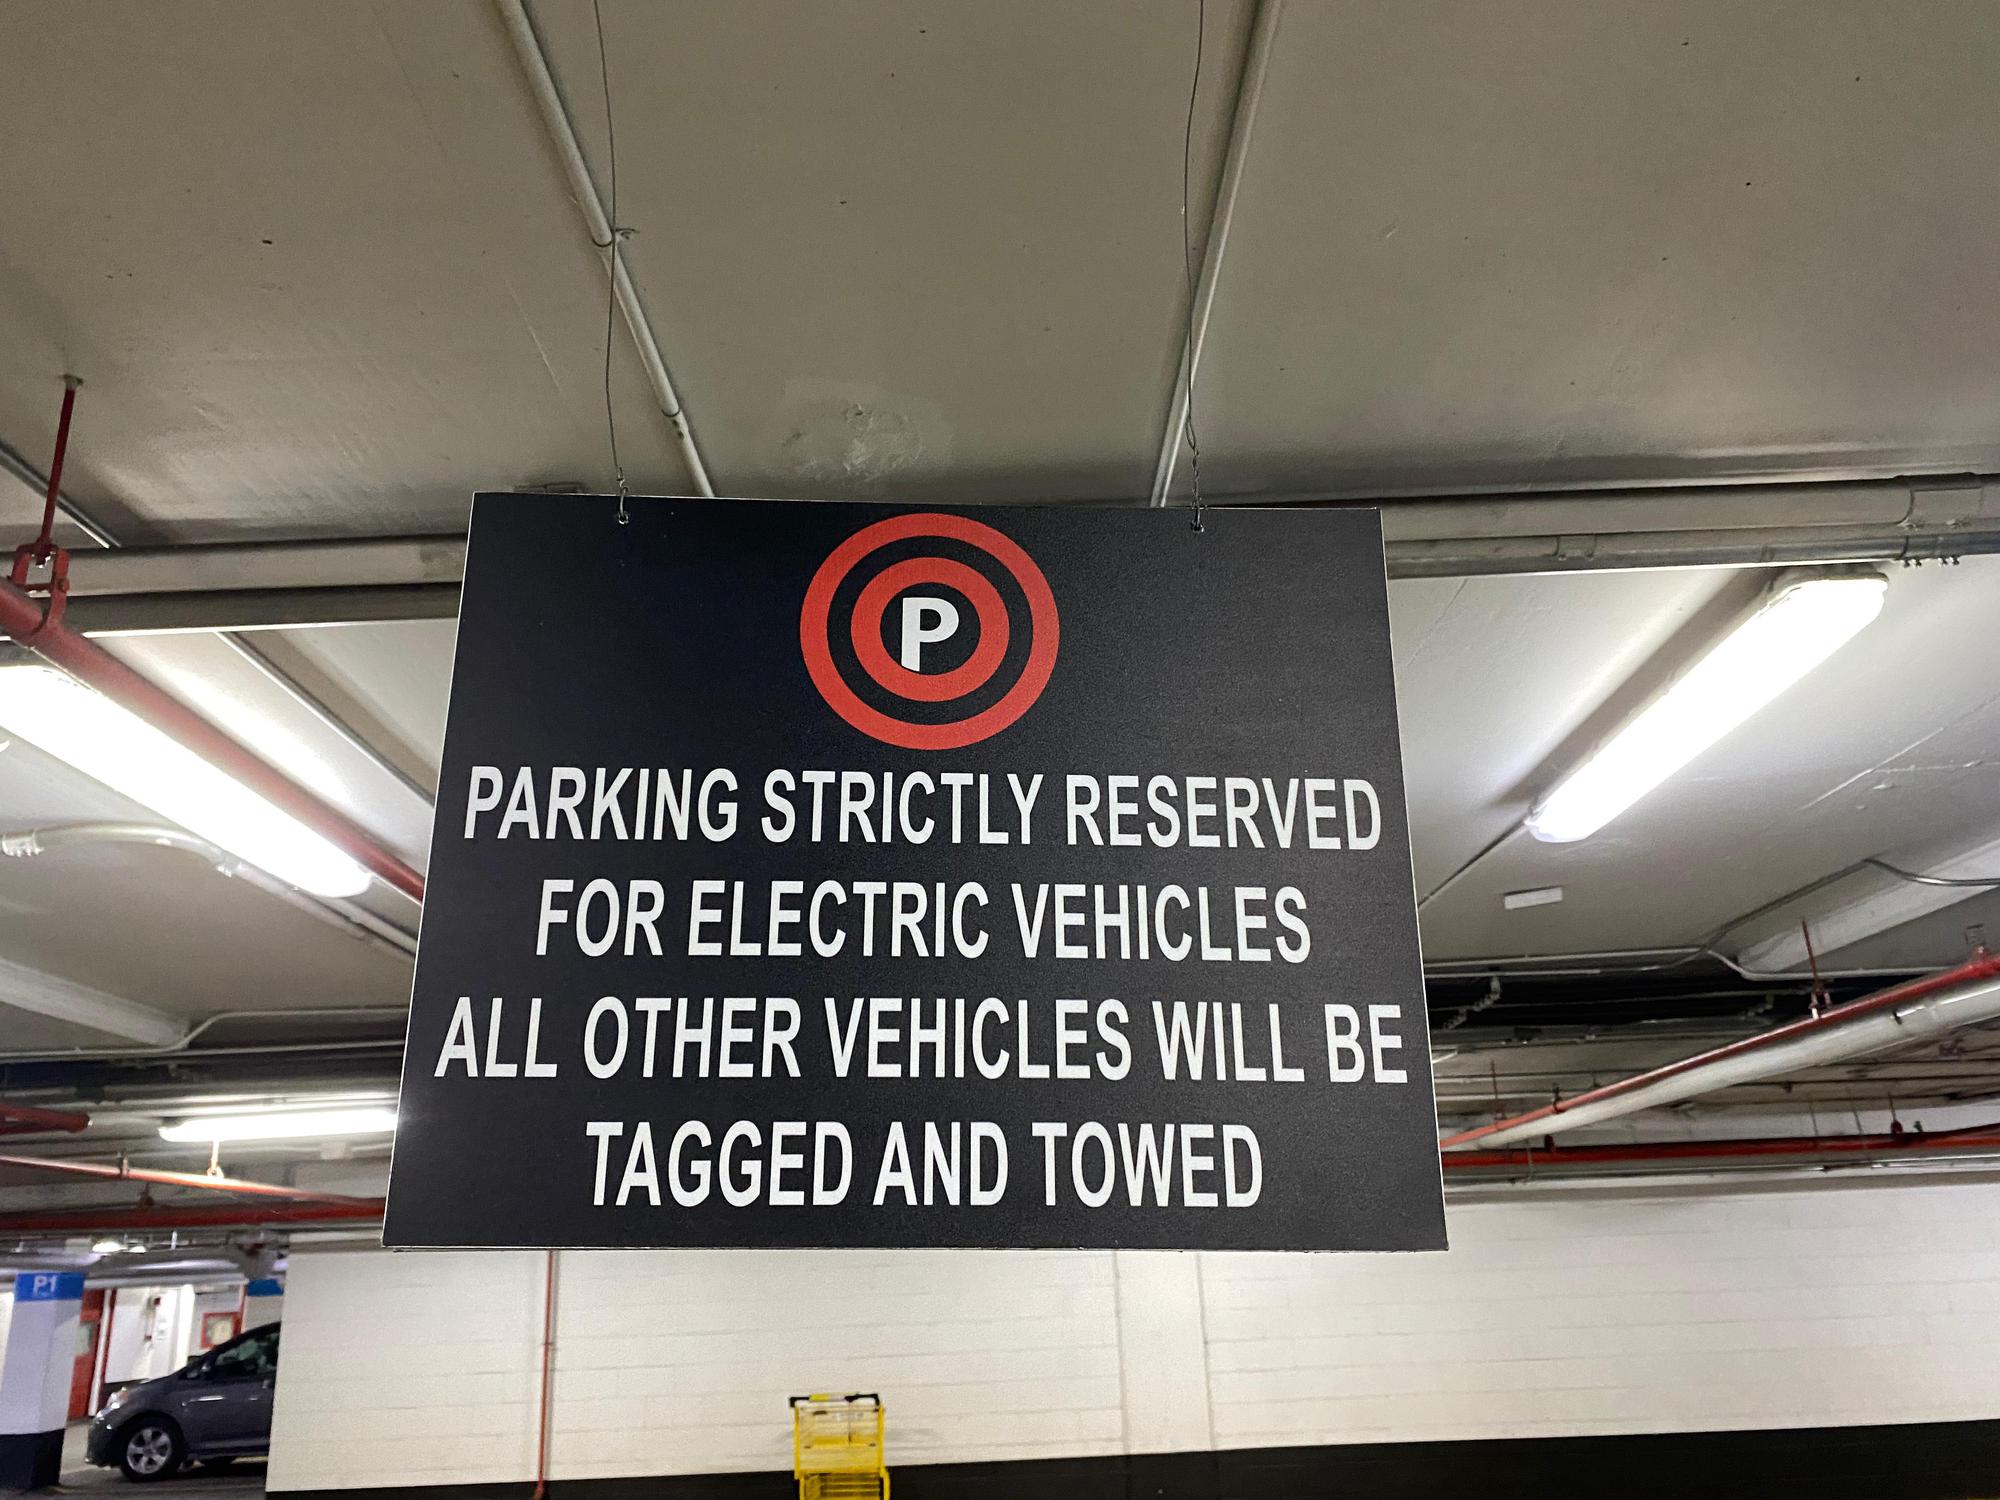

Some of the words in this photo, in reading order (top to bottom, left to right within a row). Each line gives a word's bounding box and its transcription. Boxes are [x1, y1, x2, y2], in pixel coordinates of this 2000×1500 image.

[901, 597, 960, 672] P
[463, 765, 738, 842] PARKING
[761, 768, 1044, 845] STRICTLY
[1066, 774, 1382, 851] RESERVED
[536, 878, 665, 957] FOR
[687, 879, 989, 959] ELECTRIC
[1010, 883, 1311, 964] VEHICLES
[433, 996, 558, 1078] ALL
[583, 996, 802, 1079] OTHER
[824, 997, 1132, 1081] VEHICLES
[1151, 1000, 1306, 1083] WILL
[1324, 1003, 1408, 1084] BE
[585, 1120, 853, 1208] TAGGED
[872, 1121, 1009, 1206] AND
[1031, 1121, 1263, 1208] TOWED
[32, 1275, 57, 1296] P1
